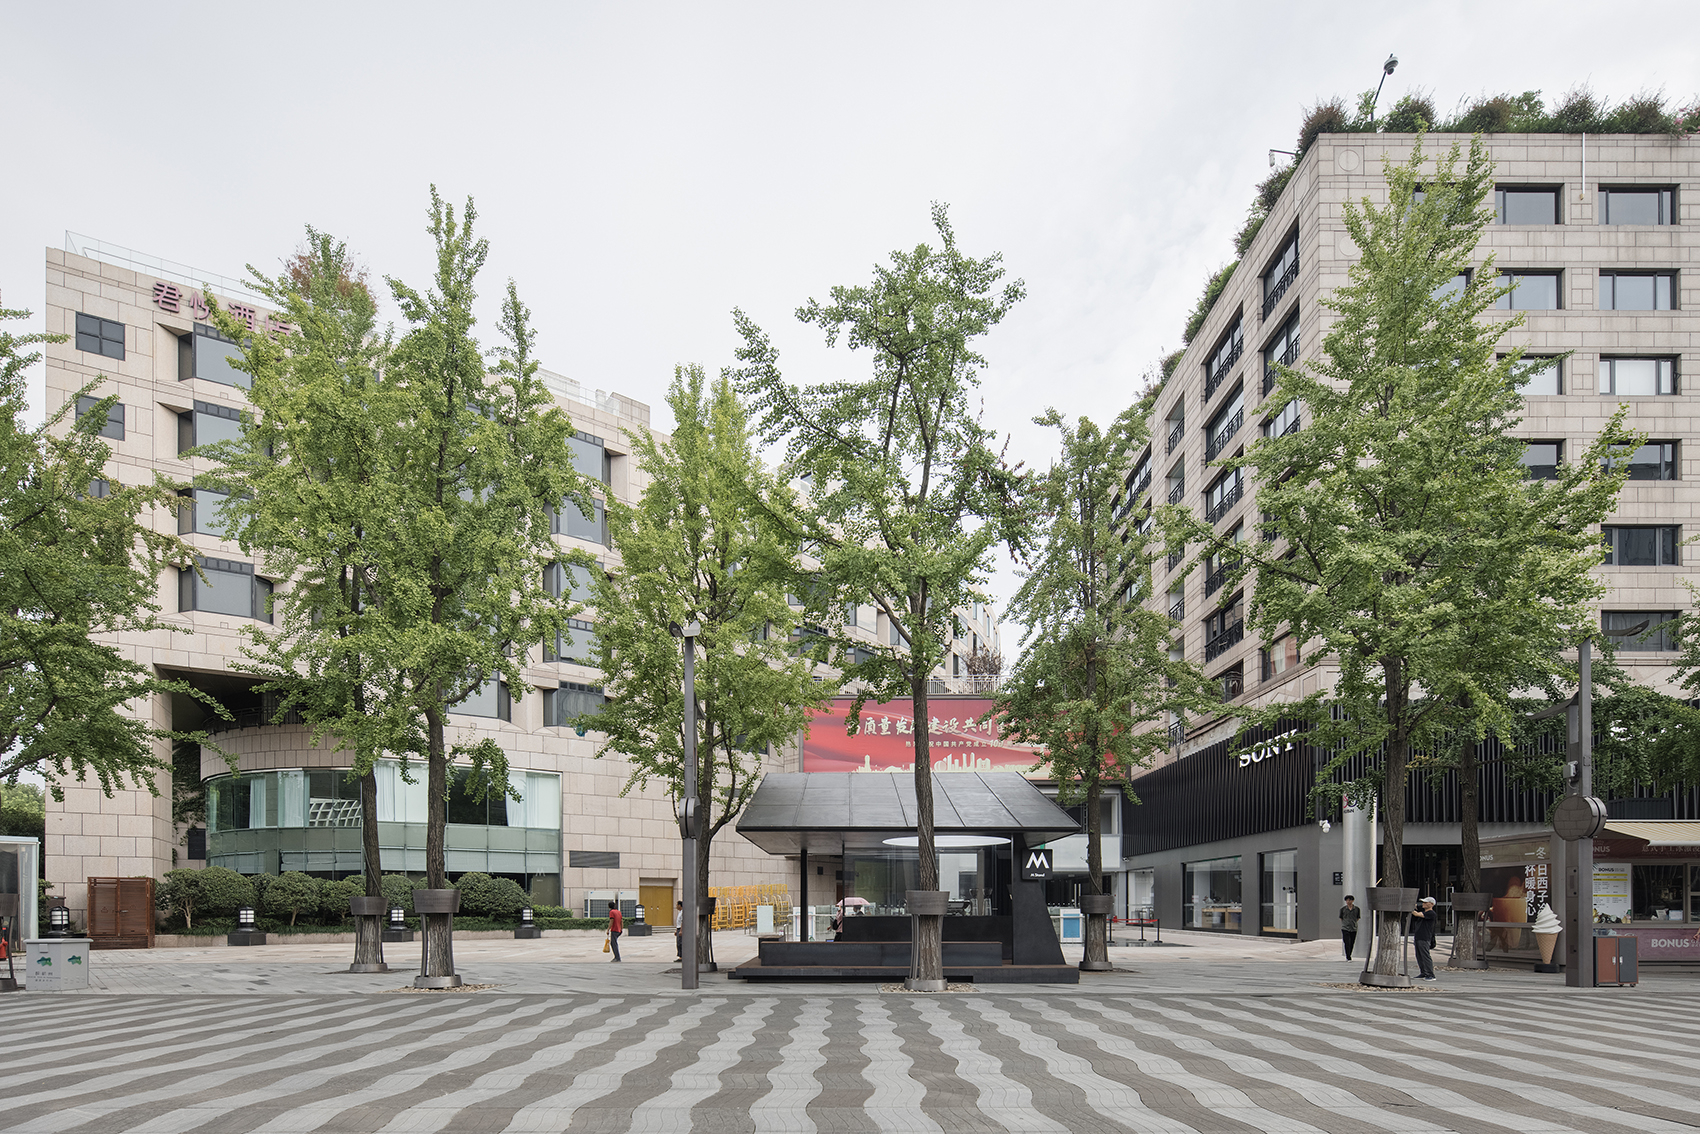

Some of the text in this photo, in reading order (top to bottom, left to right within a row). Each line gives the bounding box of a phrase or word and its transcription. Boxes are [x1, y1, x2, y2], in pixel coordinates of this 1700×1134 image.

[846, 716, 1018, 736] 质量发建设共同
[1239, 728, 1298, 768] SONY
[1025, 852, 1050, 869] M
[1524, 852, 1537, 916] 一杯暖身心
[1651, 938, 1690, 948] BONUS
